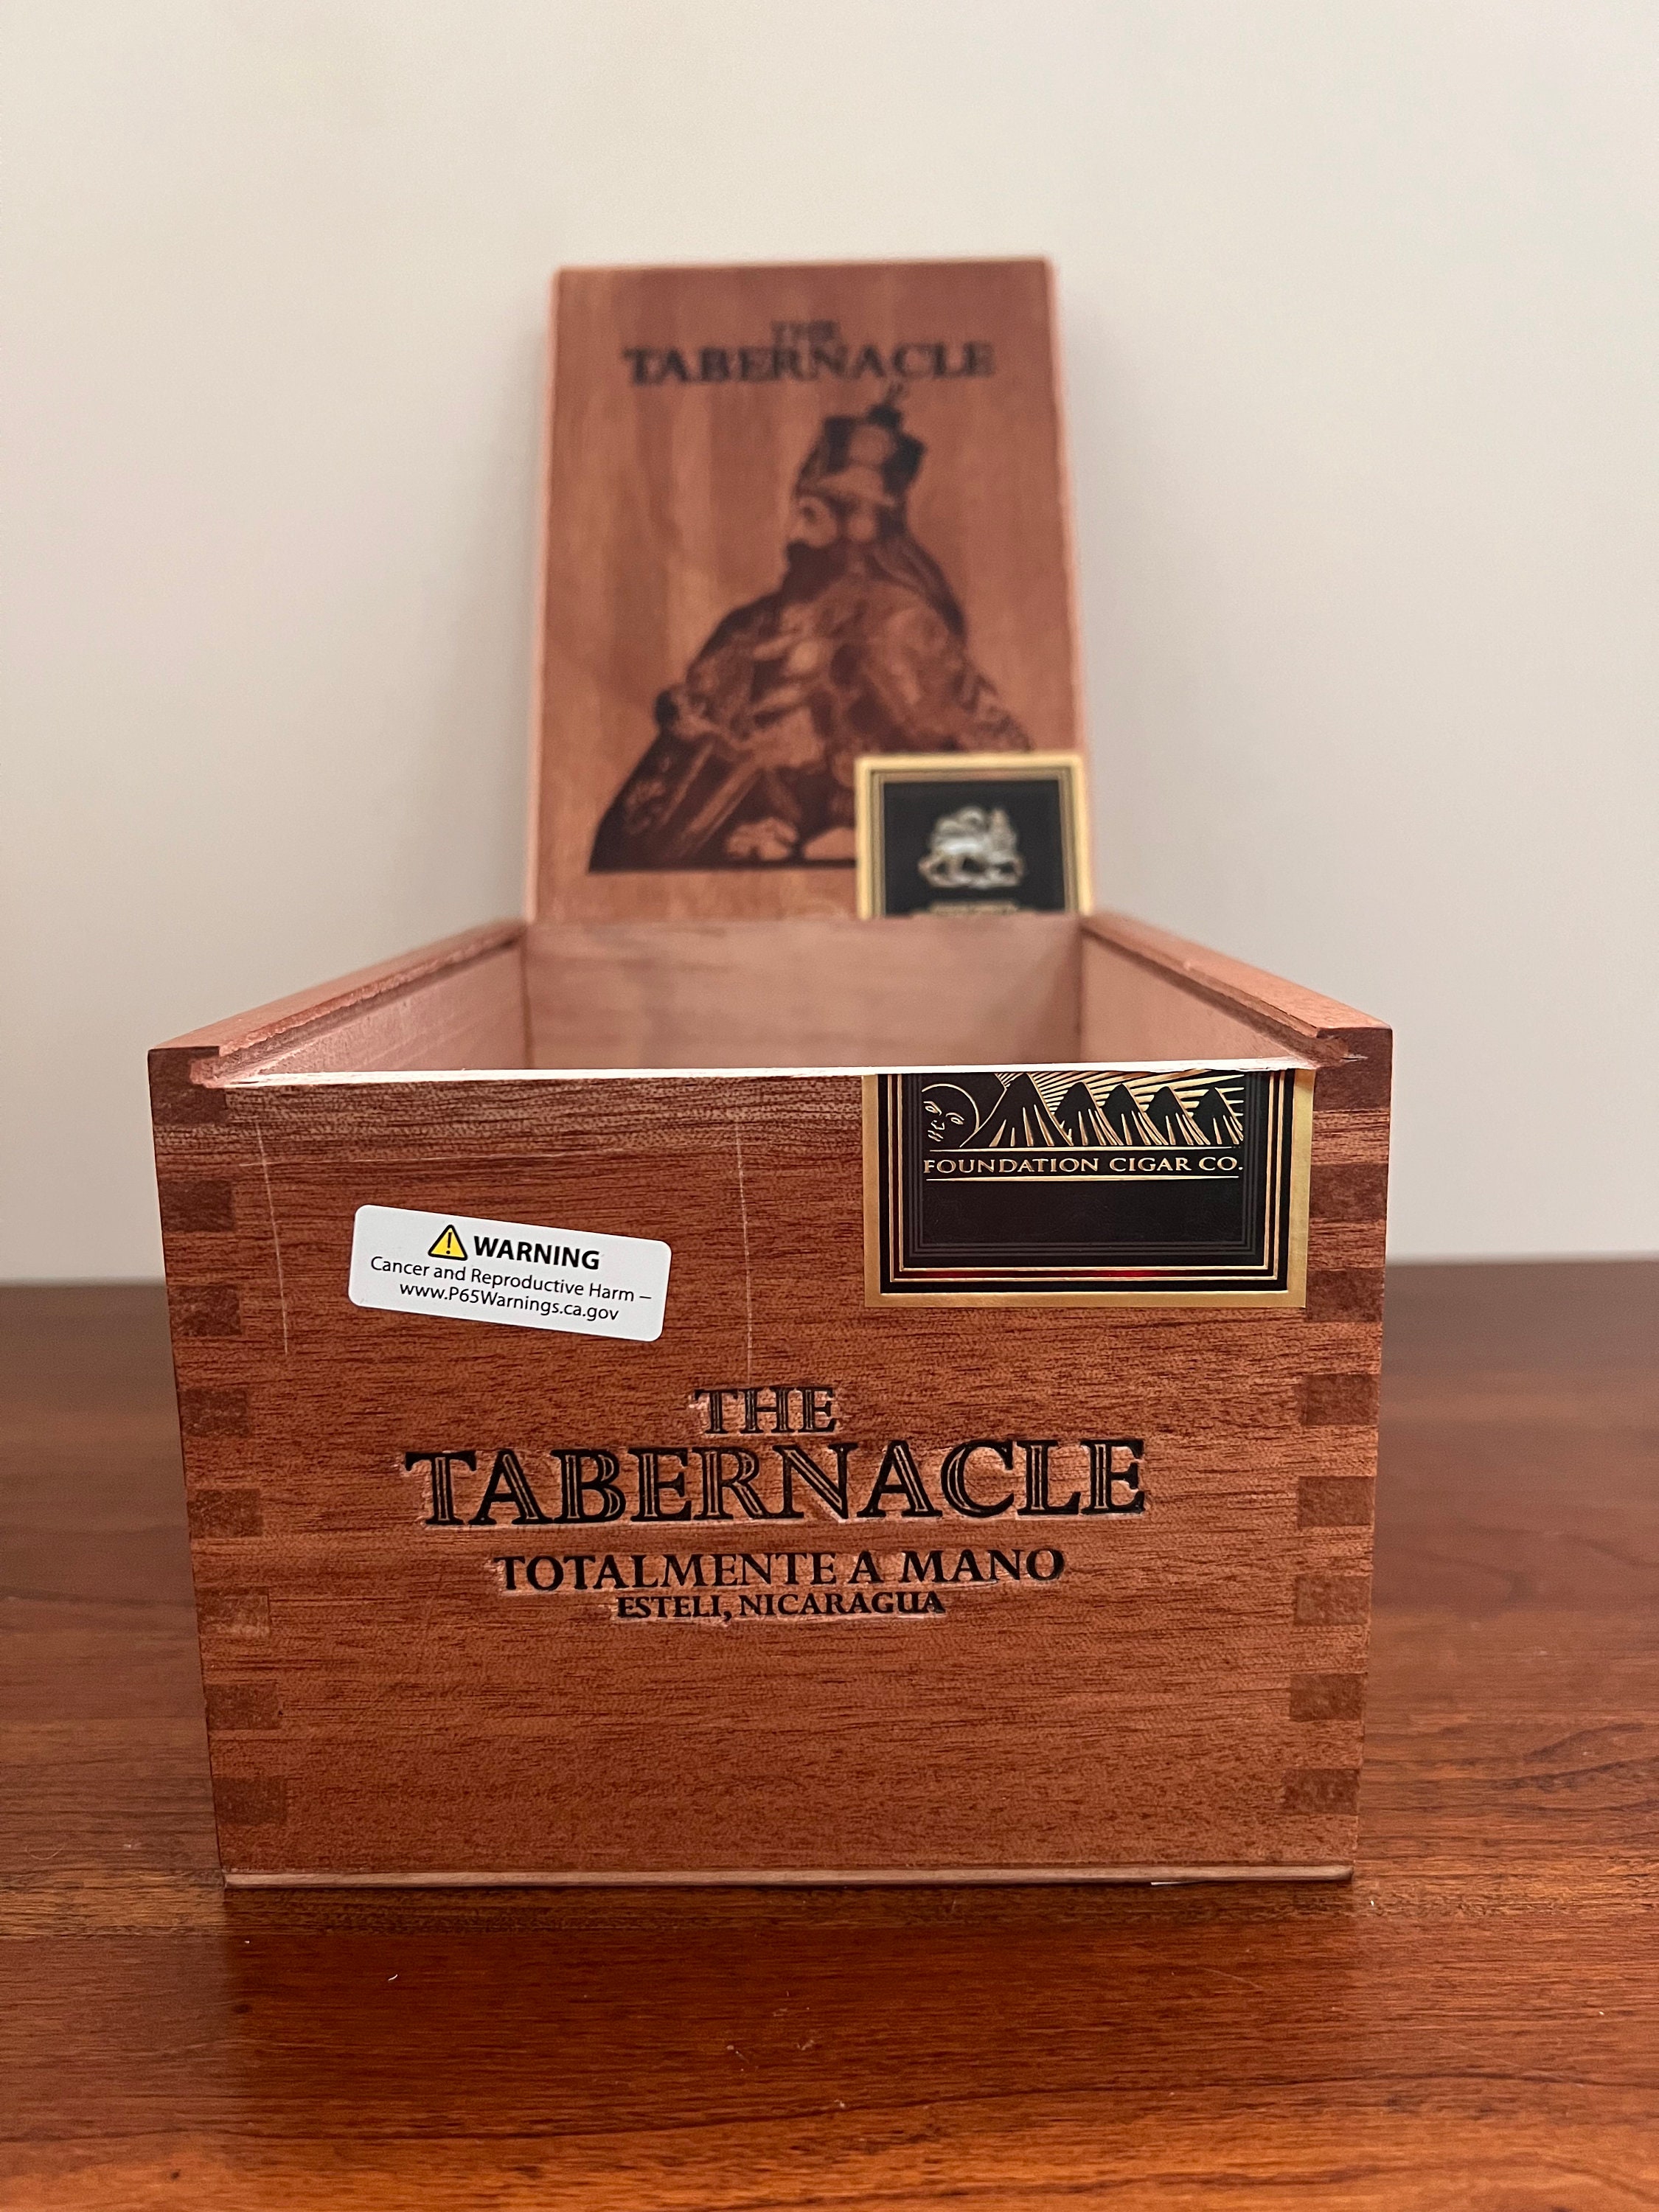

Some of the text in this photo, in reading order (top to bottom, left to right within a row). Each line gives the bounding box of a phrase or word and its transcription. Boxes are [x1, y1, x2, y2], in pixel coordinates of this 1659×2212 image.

[771, 321, 839, 345] THE
[622, 341, 995, 386] TABERNACLE
[923, 1155, 1244, 1174] FOUNDATION CIGAR CO.
[473, 1235, 601, 1270] WARNING
[370, 1256, 431, 1278] Cancer
[434, 1266, 466, 1282] and
[471, 1268, 585, 1296] Reproductive
[589, 1284, 635, 1302] Harm
[400, 1283, 619, 1322] www.P65Warnings.ca.gov
[695, 1385, 837, 1434] THE
[405, 1439, 1146, 1525] TABERNACLE
[493, 1548, 1065, 1591] TOTALMENTE A MANO
[616, 1590, 946, 1621] ESTELI, NICARAGUA
